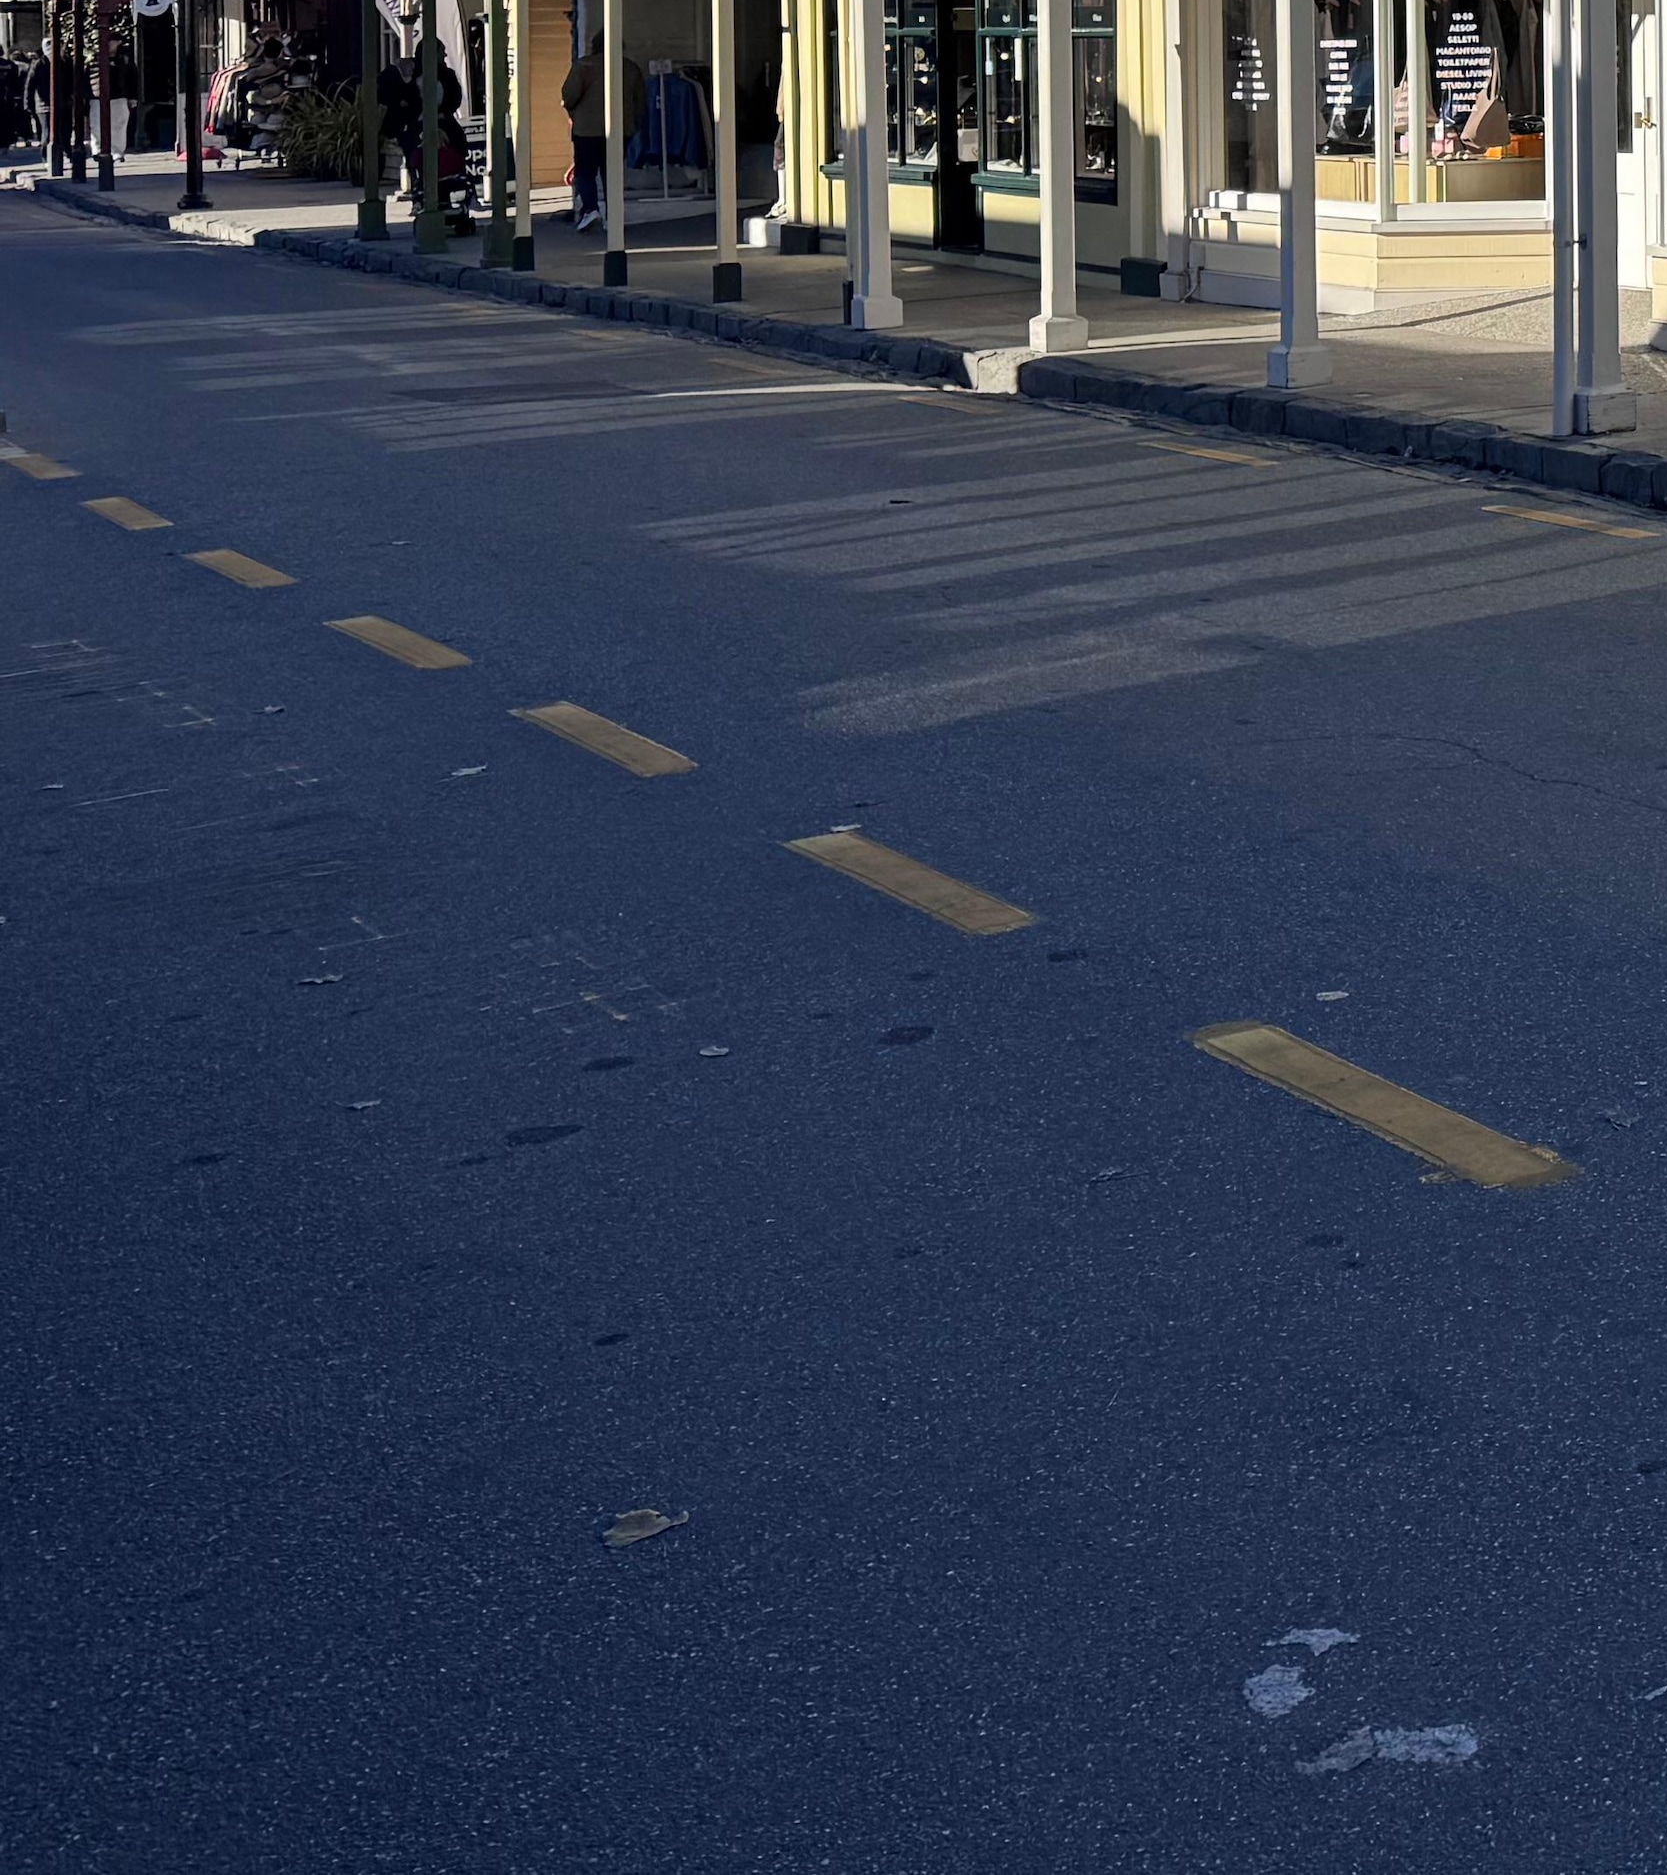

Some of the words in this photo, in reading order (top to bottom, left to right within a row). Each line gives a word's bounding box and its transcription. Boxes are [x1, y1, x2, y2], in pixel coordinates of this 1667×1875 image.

[1449, 24, 1477, 33] AESOP
[1447, 35, 1480, 44] SELETTI
[1440, 81, 1472, 90] STUDIO
